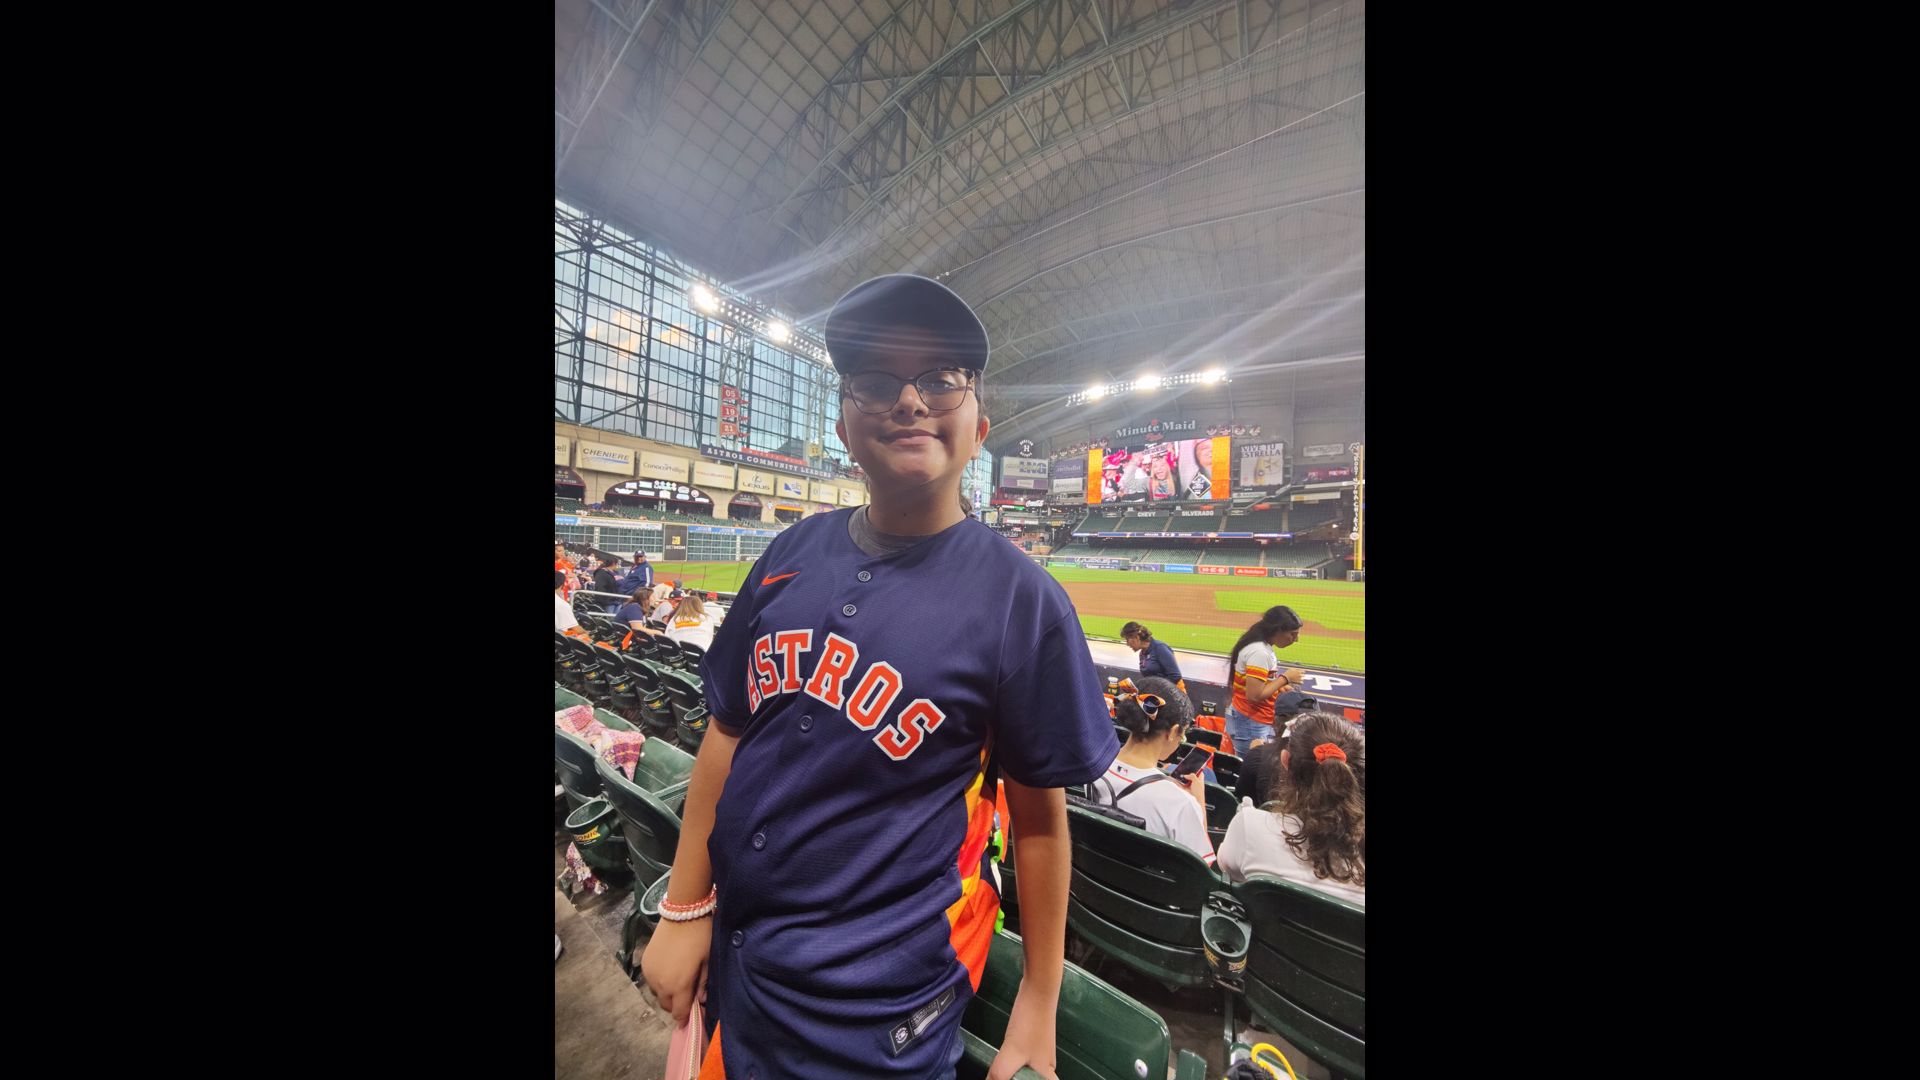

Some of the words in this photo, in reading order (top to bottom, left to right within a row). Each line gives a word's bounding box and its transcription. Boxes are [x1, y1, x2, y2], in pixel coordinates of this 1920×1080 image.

[725, 389, 736, 399] 05
[1115, 424, 1160, 439] Minute
[1162, 419, 1196, 431] Maid
[582, 447, 630, 461] CHENIERE
[1241, 449, 1281, 458] ESTRELLA
[707, 447, 743, 461] ASTROS
[746, 455, 798, 472] COMMUNITY
[800, 465, 832, 478] LEADERS
[742, 481, 770, 490] LEXUS
[747, 628, 946, 761] ASTROS
